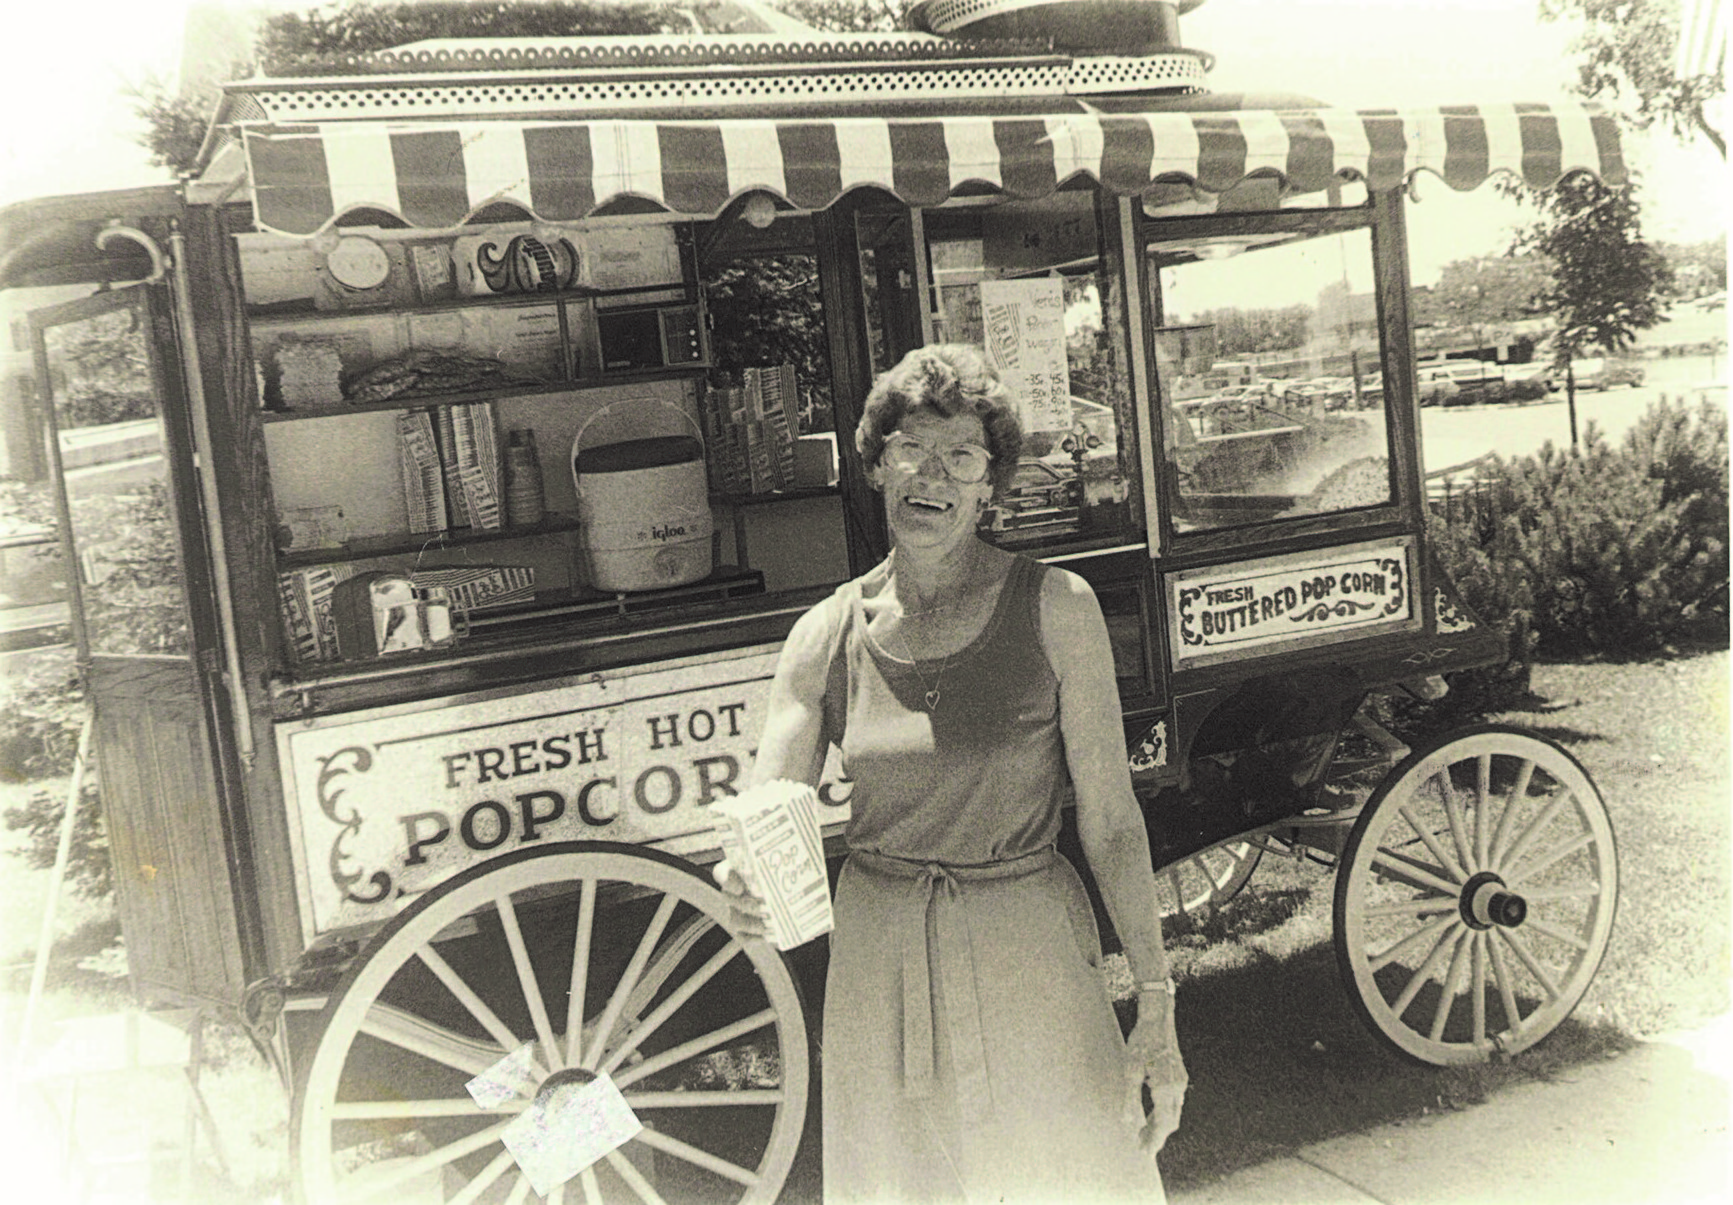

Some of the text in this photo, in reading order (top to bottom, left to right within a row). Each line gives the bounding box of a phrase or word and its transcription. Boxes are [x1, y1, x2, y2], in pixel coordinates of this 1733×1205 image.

[652, 525, 686, 541] igloo
[1201, 572, 1386, 636] BUTTERED POP CORN
[1206, 586, 1254, 605] FRESH
[443, 703, 745, 788] FRESH HOT
[400, 748, 760, 867] POPCOR
